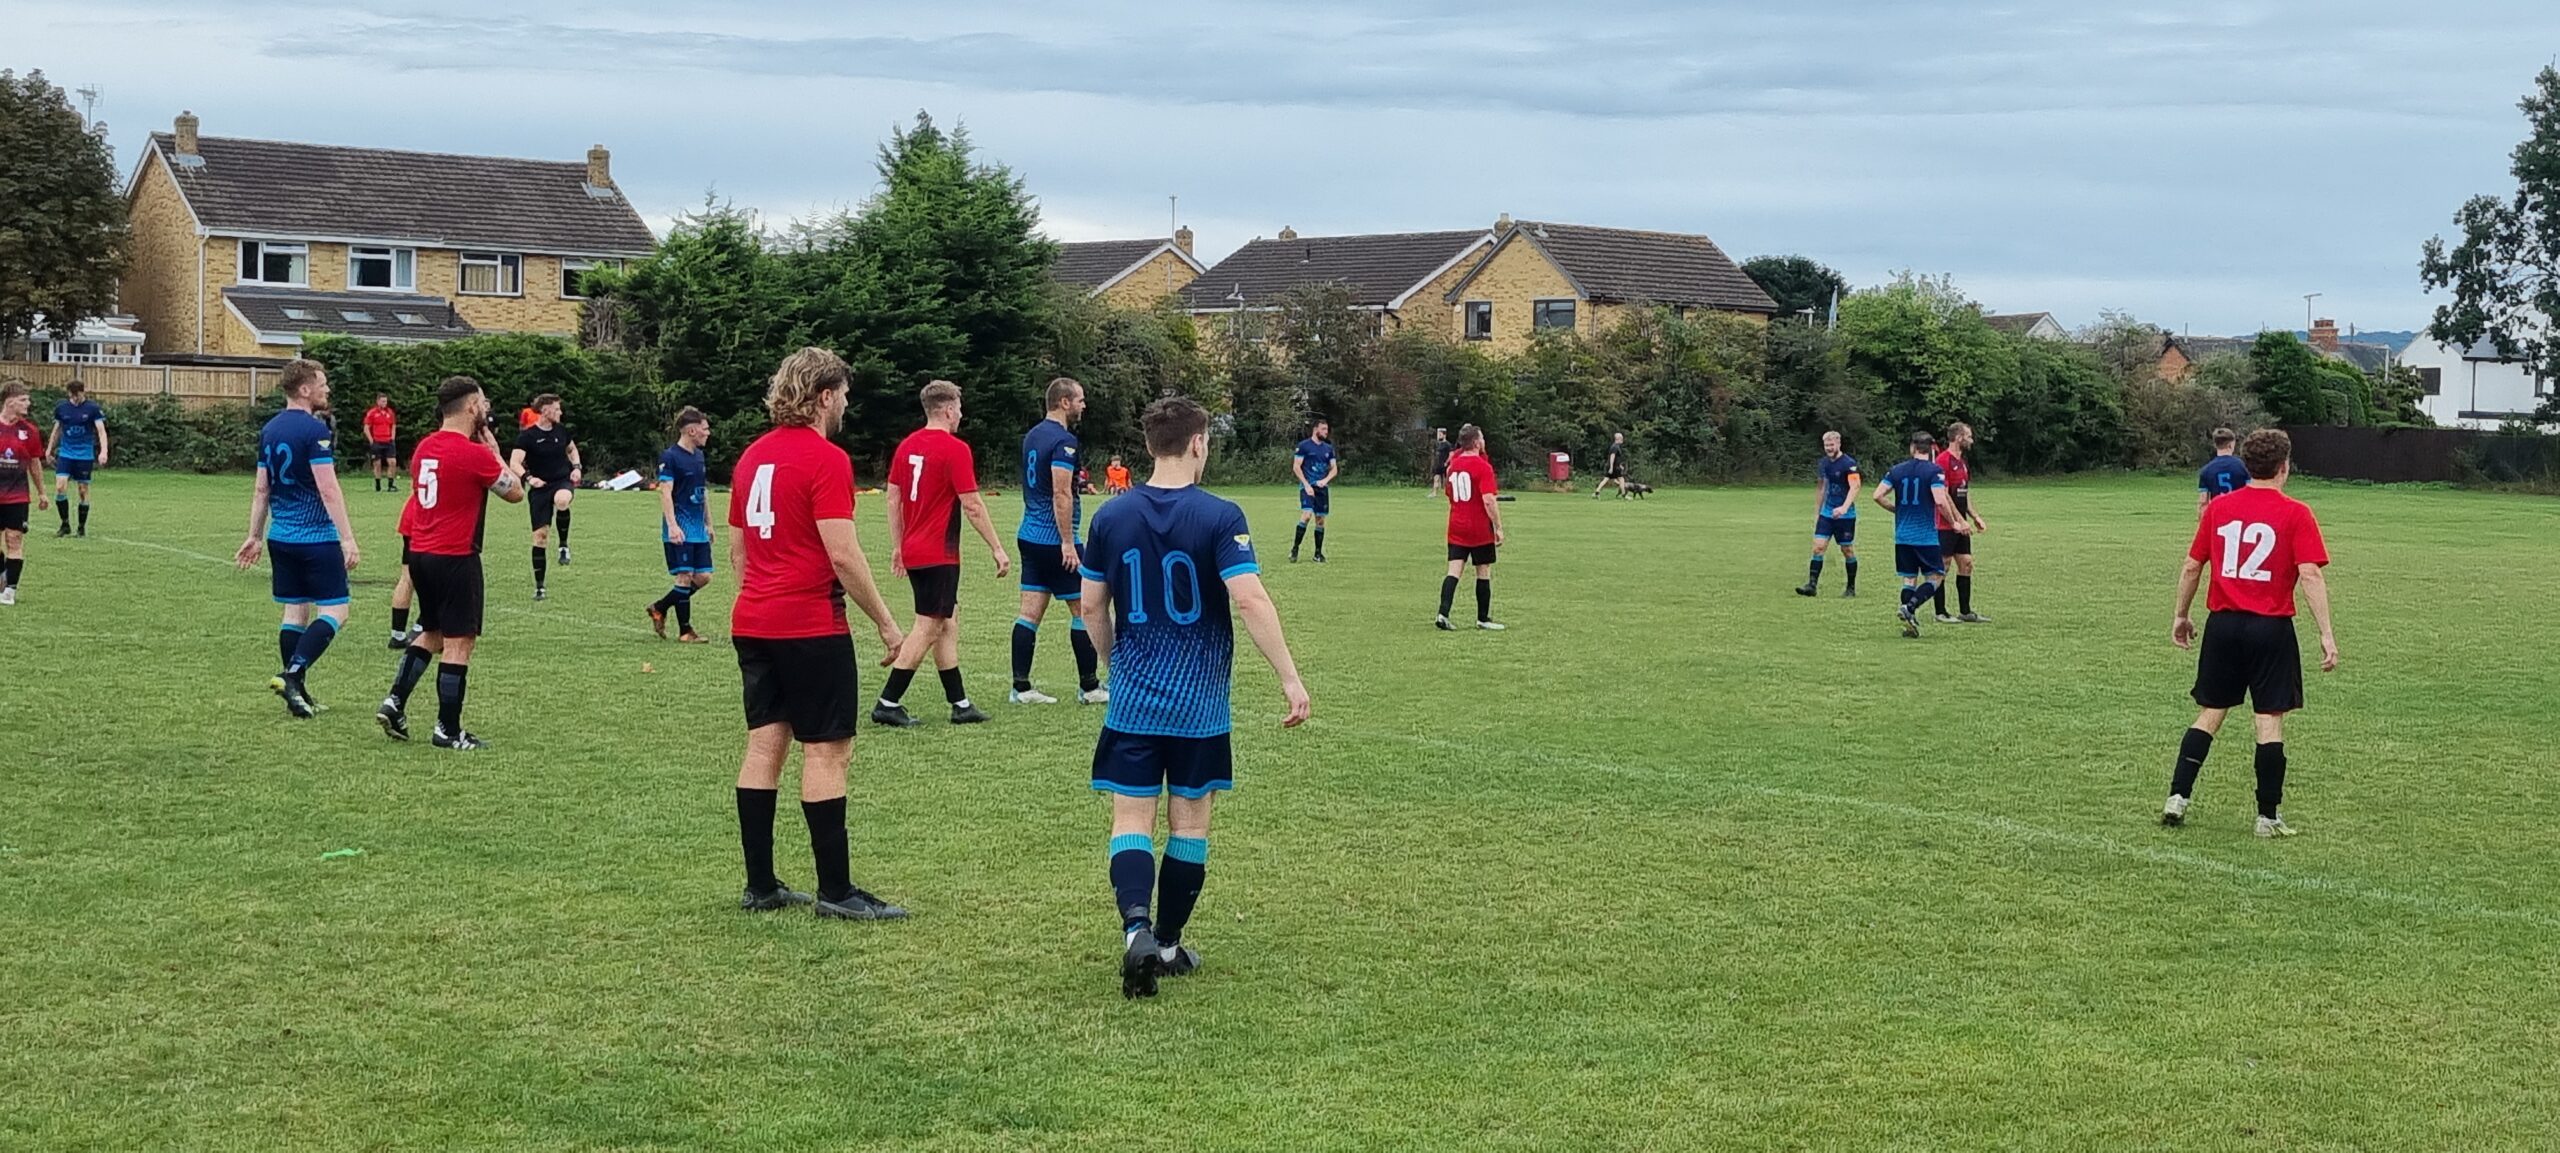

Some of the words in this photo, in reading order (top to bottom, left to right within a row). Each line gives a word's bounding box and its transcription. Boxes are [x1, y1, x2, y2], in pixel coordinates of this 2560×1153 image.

[418, 459, 439, 508] 5
[909, 455, 924, 501] 7
[1027, 449, 1037, 488] 8
[1449, 472, 1471, 502] 10
[1901, 477, 1920, 505] 11
[2218, 473, 2232, 494] 5
[746, 464, 775, 538] 4
[2217, 520, 2277, 581] 12
[1122, 548, 1201, 625] 10
